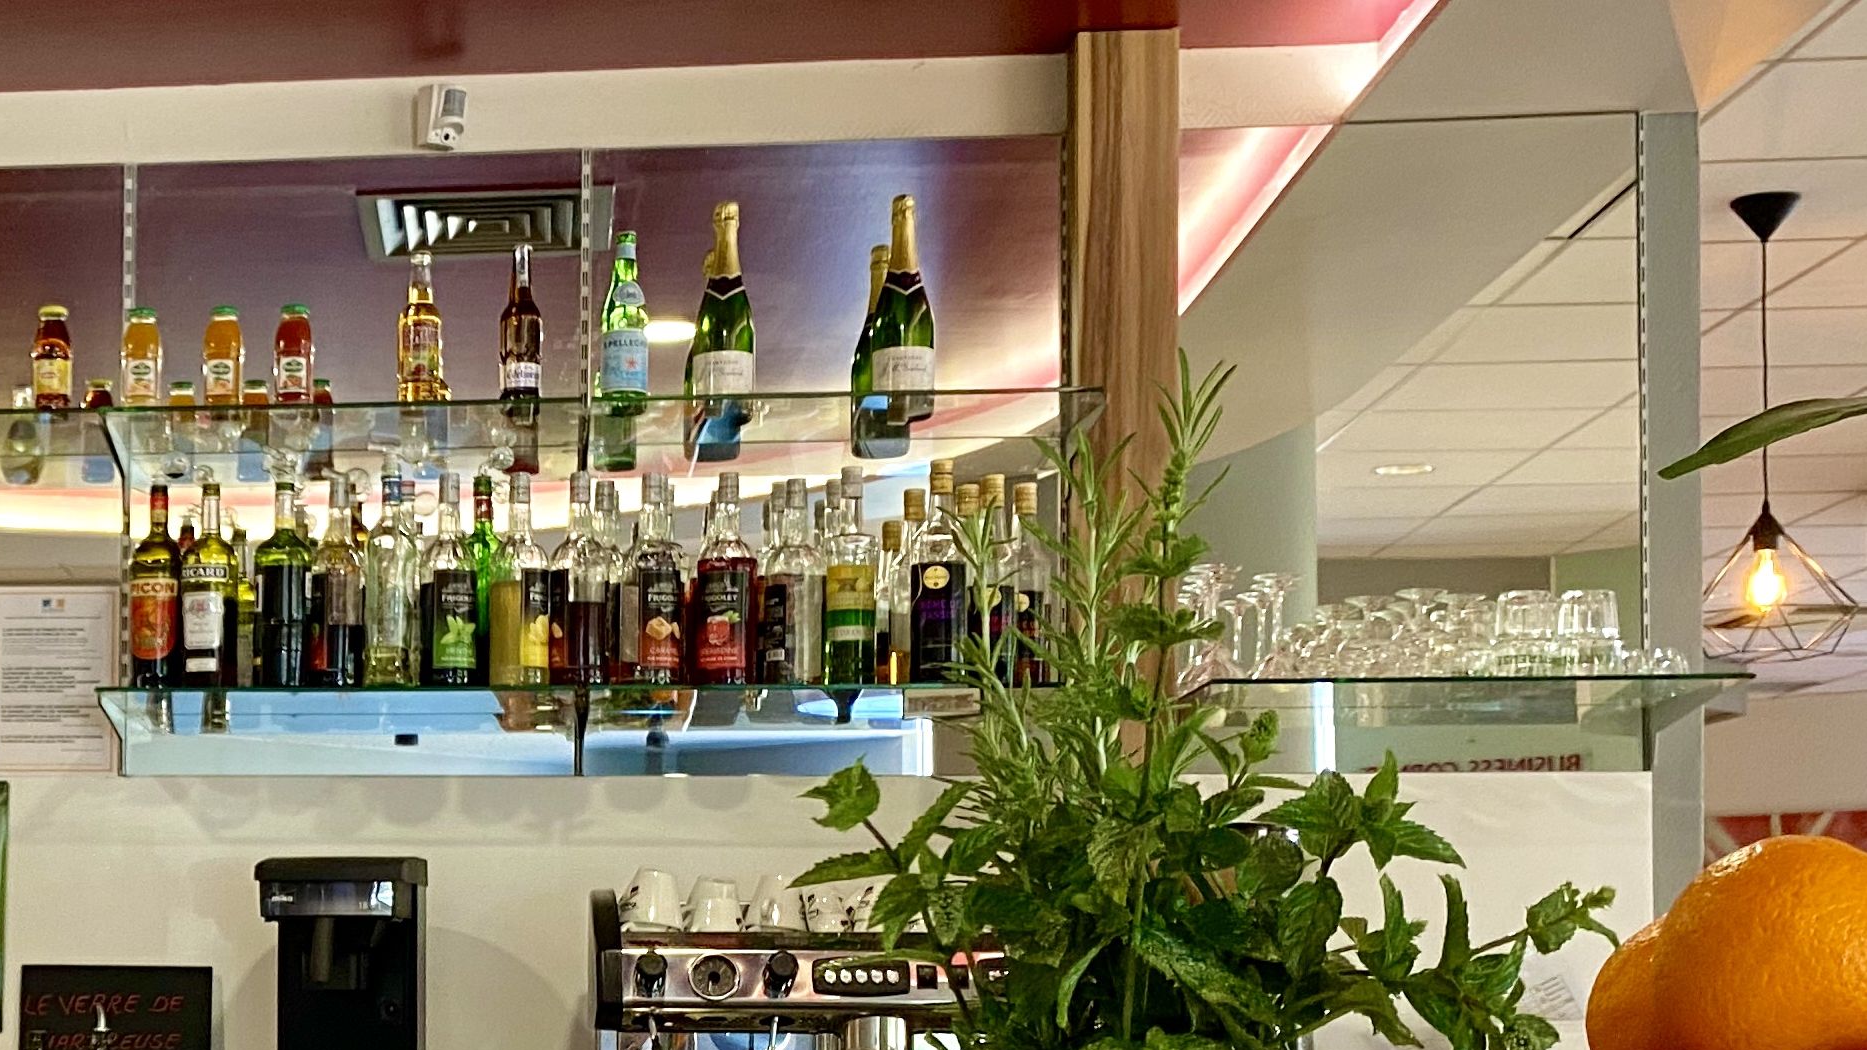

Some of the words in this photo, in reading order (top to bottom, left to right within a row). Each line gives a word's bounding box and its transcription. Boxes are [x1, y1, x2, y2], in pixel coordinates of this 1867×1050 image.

[130, 582, 175, 593] PICON
[23, 994, 53, 1015] LE
[58, 993, 142, 1015] VERRE
[149, 995, 185, 1013] DE
